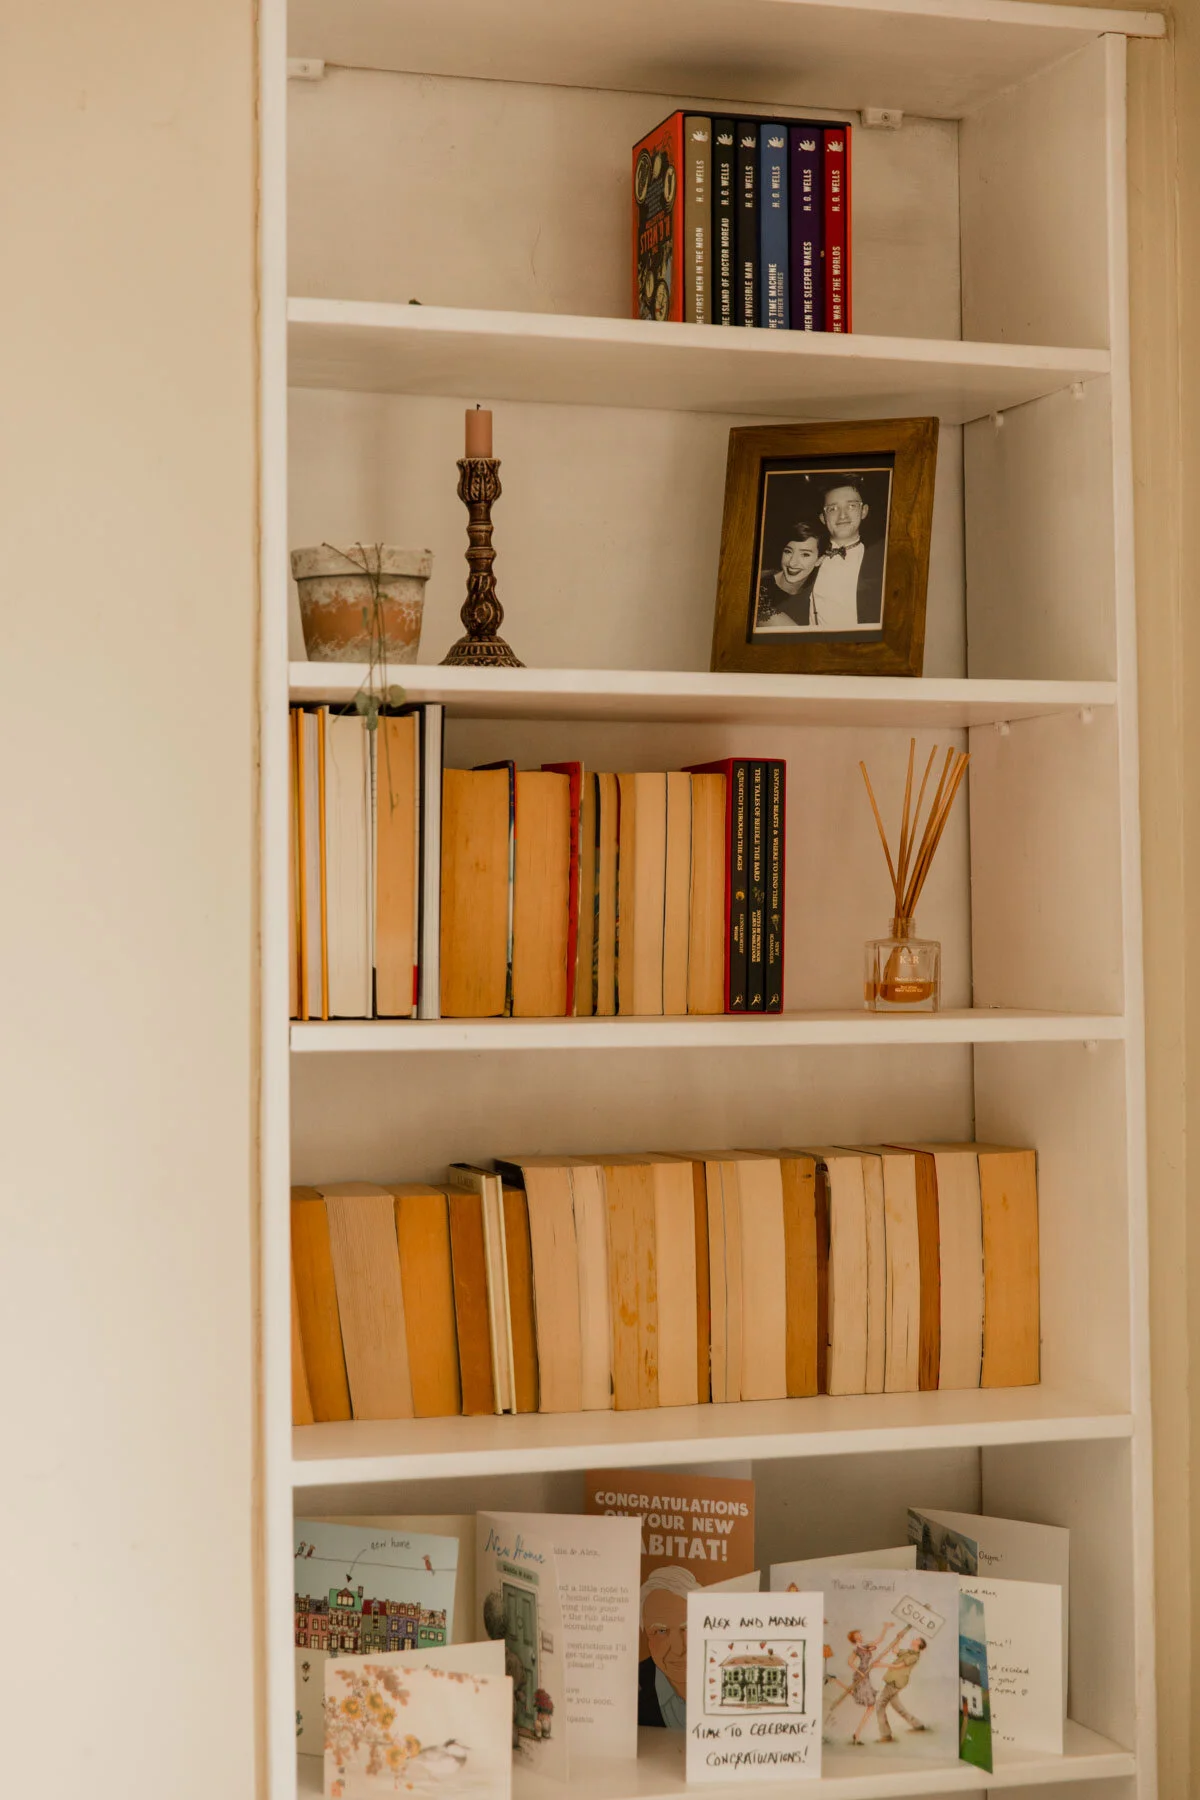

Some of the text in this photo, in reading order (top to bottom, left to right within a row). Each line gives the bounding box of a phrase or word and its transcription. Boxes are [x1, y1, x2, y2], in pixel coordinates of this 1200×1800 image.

[696, 160, 704, 184] WELLS
[721, 163, 730, 186] WELLS
[745, 166, 754, 189] WELLS
[772, 166, 780, 189] WELLS
[803, 170, 812, 192] WELLS
[832, 170, 840, 193] WELLS
[696, 228, 704, 248] MOON
[696, 250, 704, 264] THE
[804, 241, 812, 266] WAKES
[696, 266, 704, 274] IN
[722, 218, 730, 326] HE ISLAND OF DOCTOR MOREAU
[696, 276, 704, 292] MEN
[804, 268, 812, 298] SLEEPER
[832, 246, 841, 333] HE WAR OF THE WORLDS
[696, 294, 704, 314] FIRST
[744, 262, 753, 328] HE INVISIBLE MAN
[768, 264, 777, 328] HE TIME MACHINE
[804, 300, 812, 314] THE
[754, 807, 760, 817] OF
[773, 862, 778, 872] TO
[594, 1491, 749, 1517] CONGRATULATIONS
[692, 1517, 734, 1534] NEW
[641, 1534, 728, 1562] BITAT!
[578, 1584, 598, 1592] little
[703, 1615, 807, 1630] ALEX AND MADDIE
[902, 1604, 936, 1630] SOLD
[724, 1723, 742, 1738] TO
[749, 1720, 816, 1736] CELEBRATE!
[706, 1745, 808, 1770] CONGRATULATIONS!
